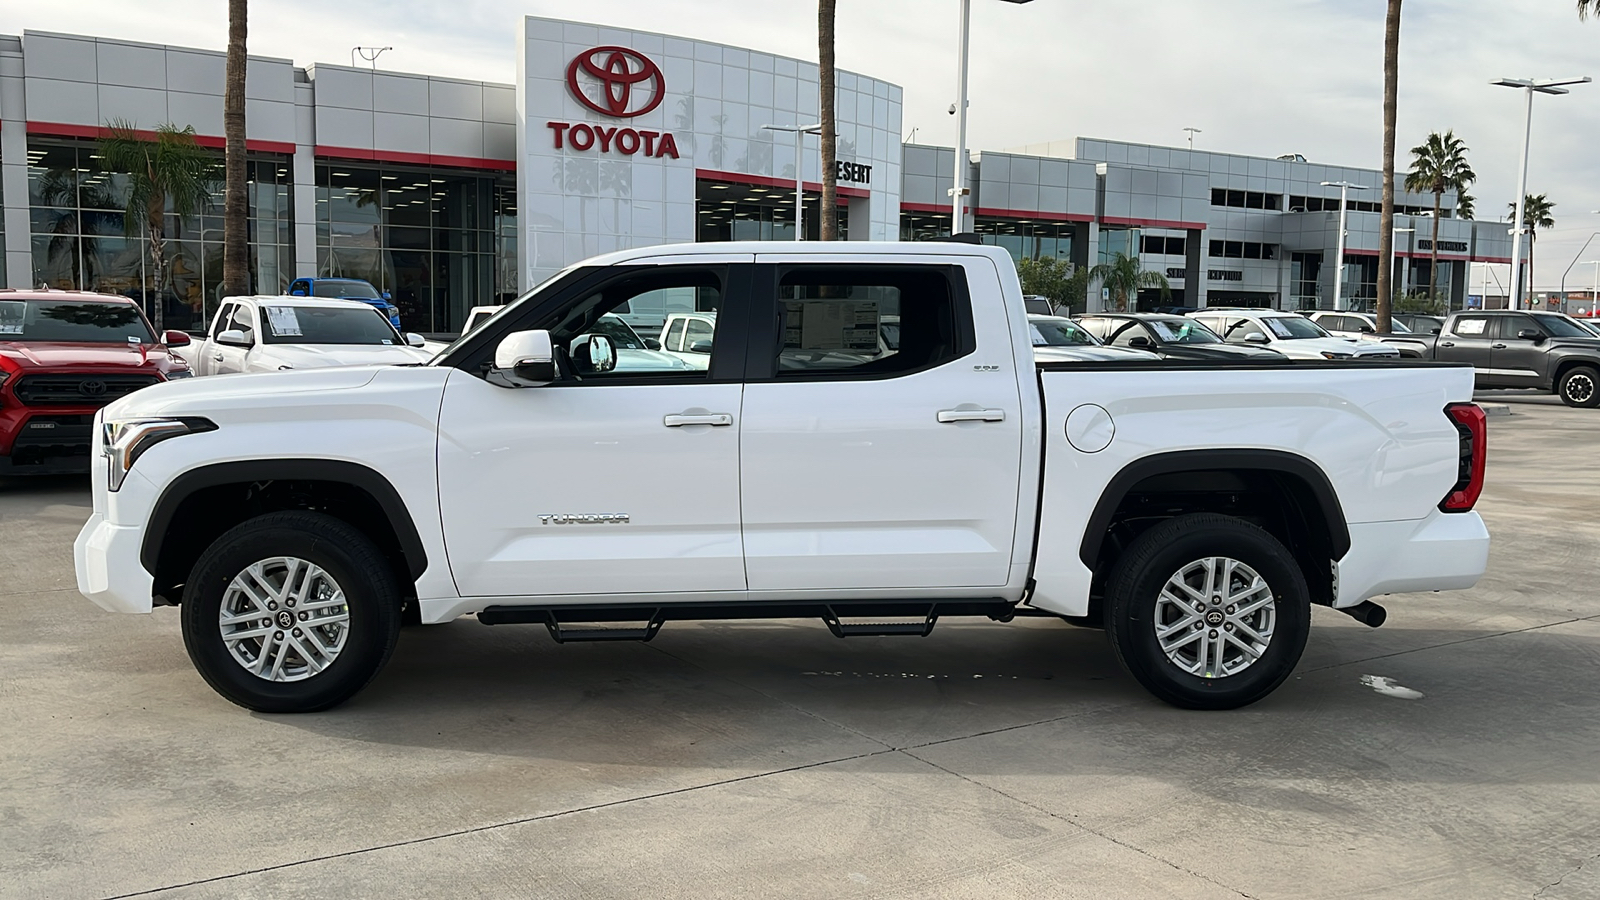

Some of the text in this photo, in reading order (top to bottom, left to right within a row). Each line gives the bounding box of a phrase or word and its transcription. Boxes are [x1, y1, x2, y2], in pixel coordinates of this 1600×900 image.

[547, 121, 680, 160] TOYOTA
[836, 160, 872, 184] ESERT
[537, 512, 630, 525] TUNDRA
